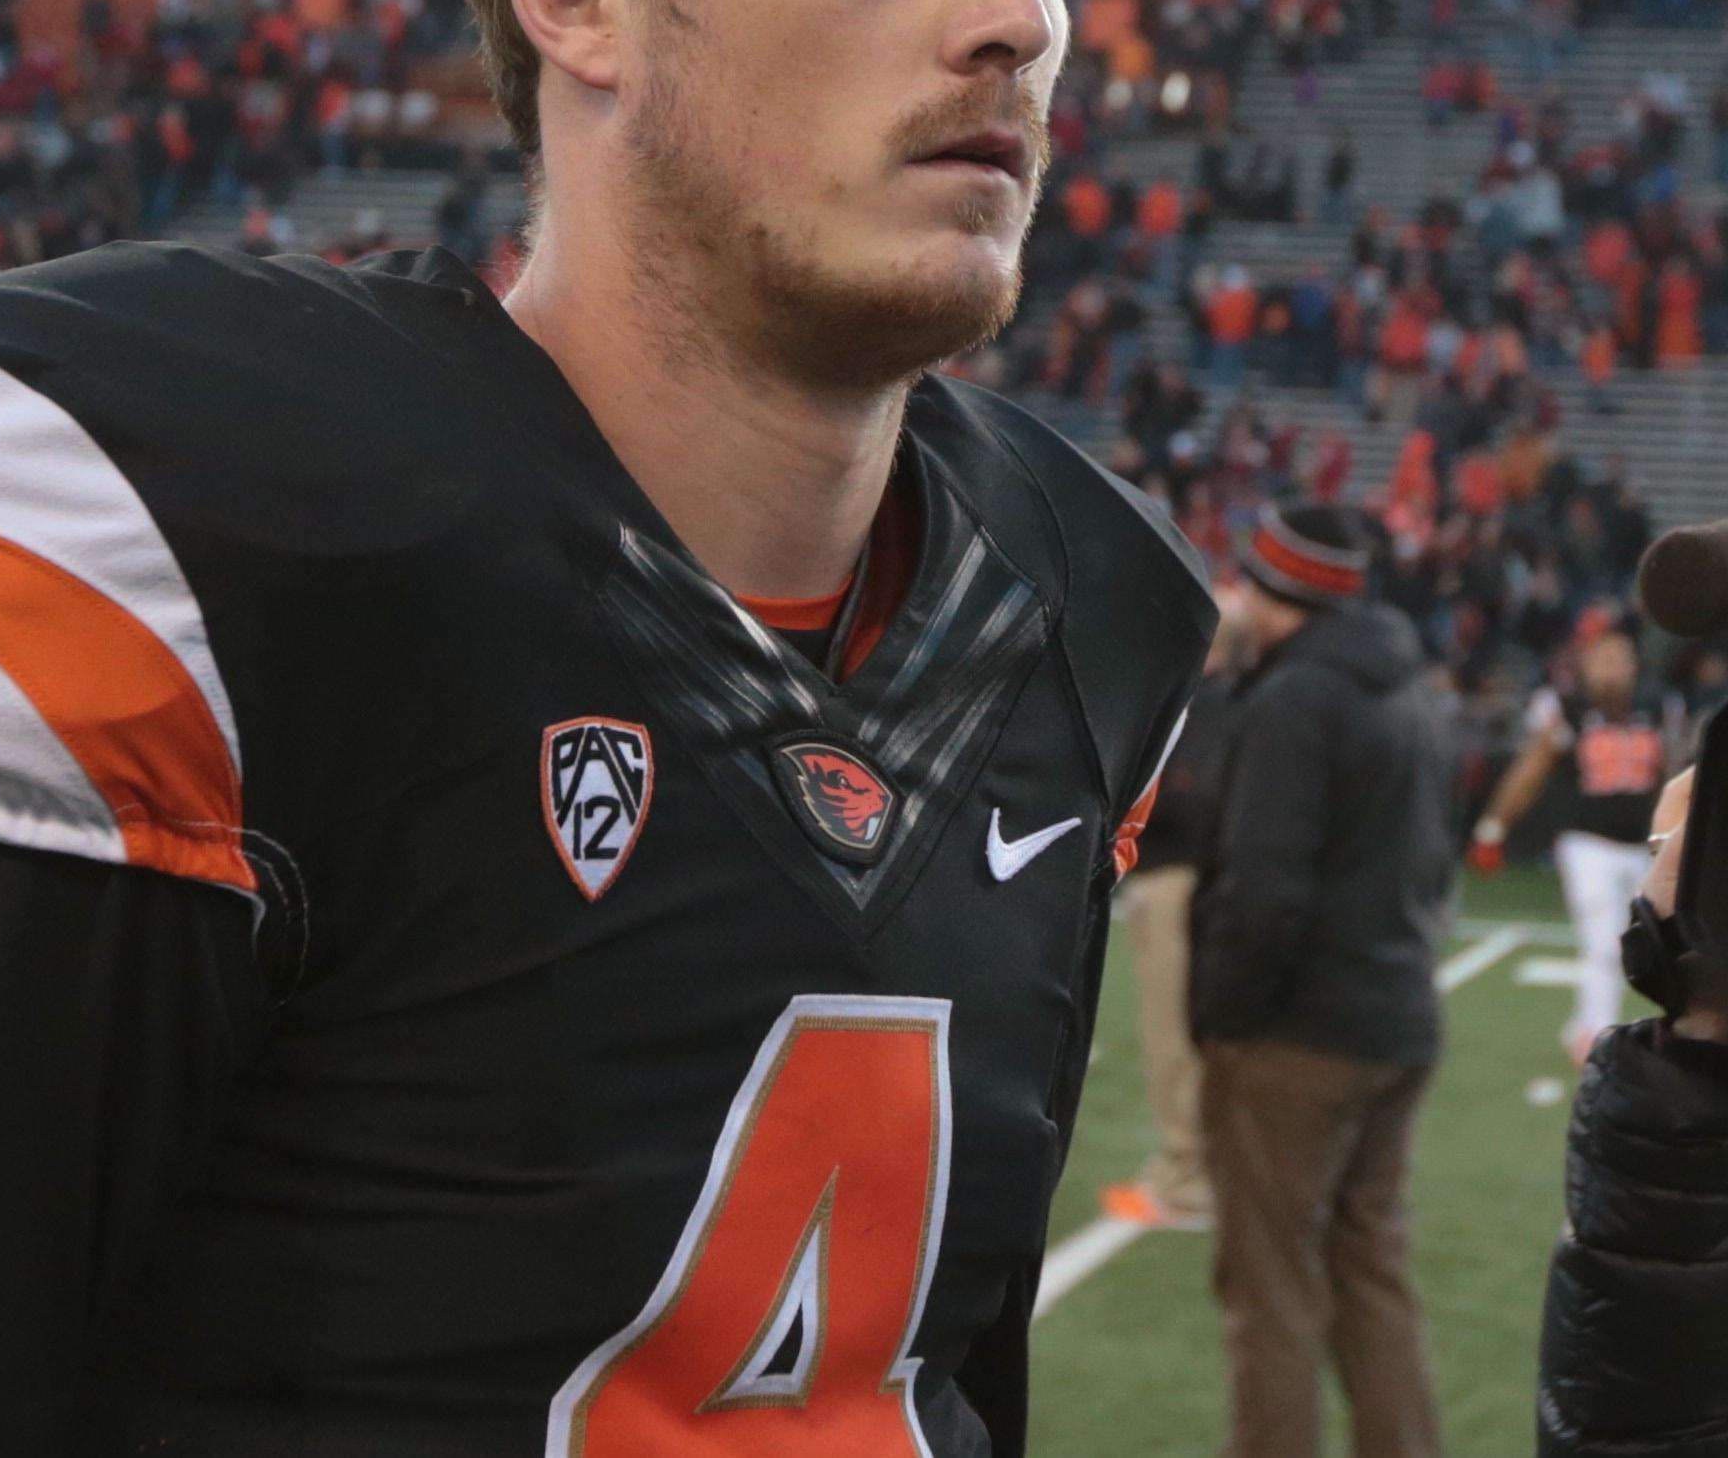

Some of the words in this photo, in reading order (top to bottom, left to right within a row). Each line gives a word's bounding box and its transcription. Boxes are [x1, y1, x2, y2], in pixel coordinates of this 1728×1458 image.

[551, 725, 644, 830] PAC
[573, 795, 621, 860] 12
[545, 993, 952, 1458] 4
